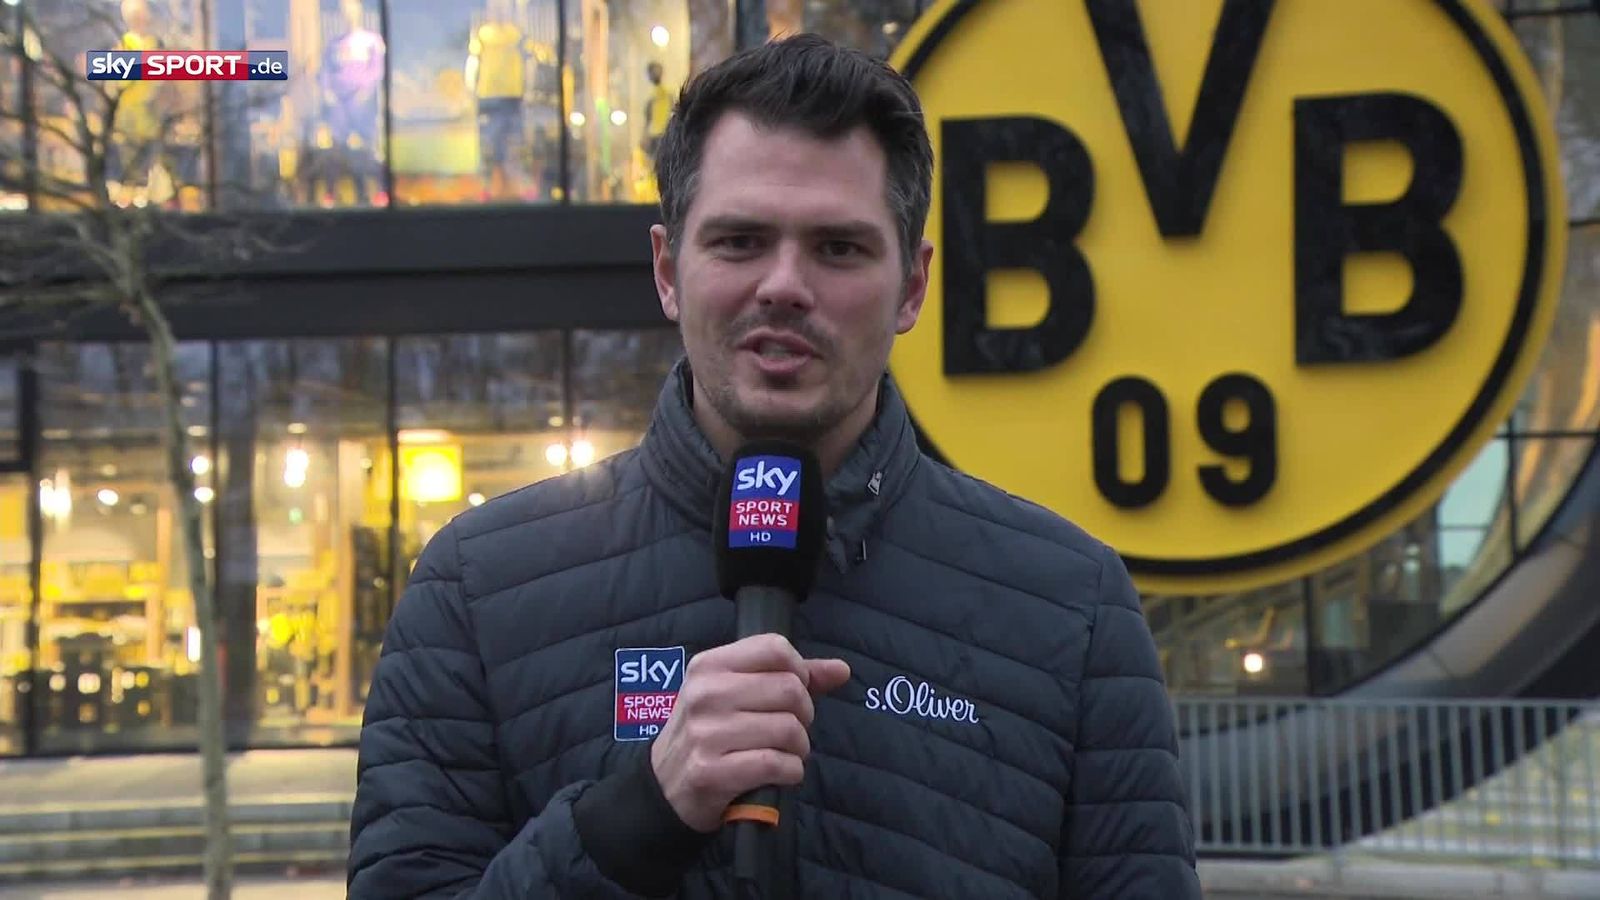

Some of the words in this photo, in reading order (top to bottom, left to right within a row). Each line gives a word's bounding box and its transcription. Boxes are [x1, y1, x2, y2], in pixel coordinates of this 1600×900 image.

[940, 0, 1465, 378] BVB
[1091, 372, 1278, 509] 09
[737, 460, 798, 496] sky
[735, 500, 793, 514] SPORT
[738, 513, 788, 526] NEWS
[750, 532, 772, 542] HD
[620, 654, 680, 690] sky
[623, 695, 677, 709] SPORT
[865, 675, 979, 724] s.Oliver
[626, 707, 672, 720] NEWS
[639, 724, 659, 736] HD
